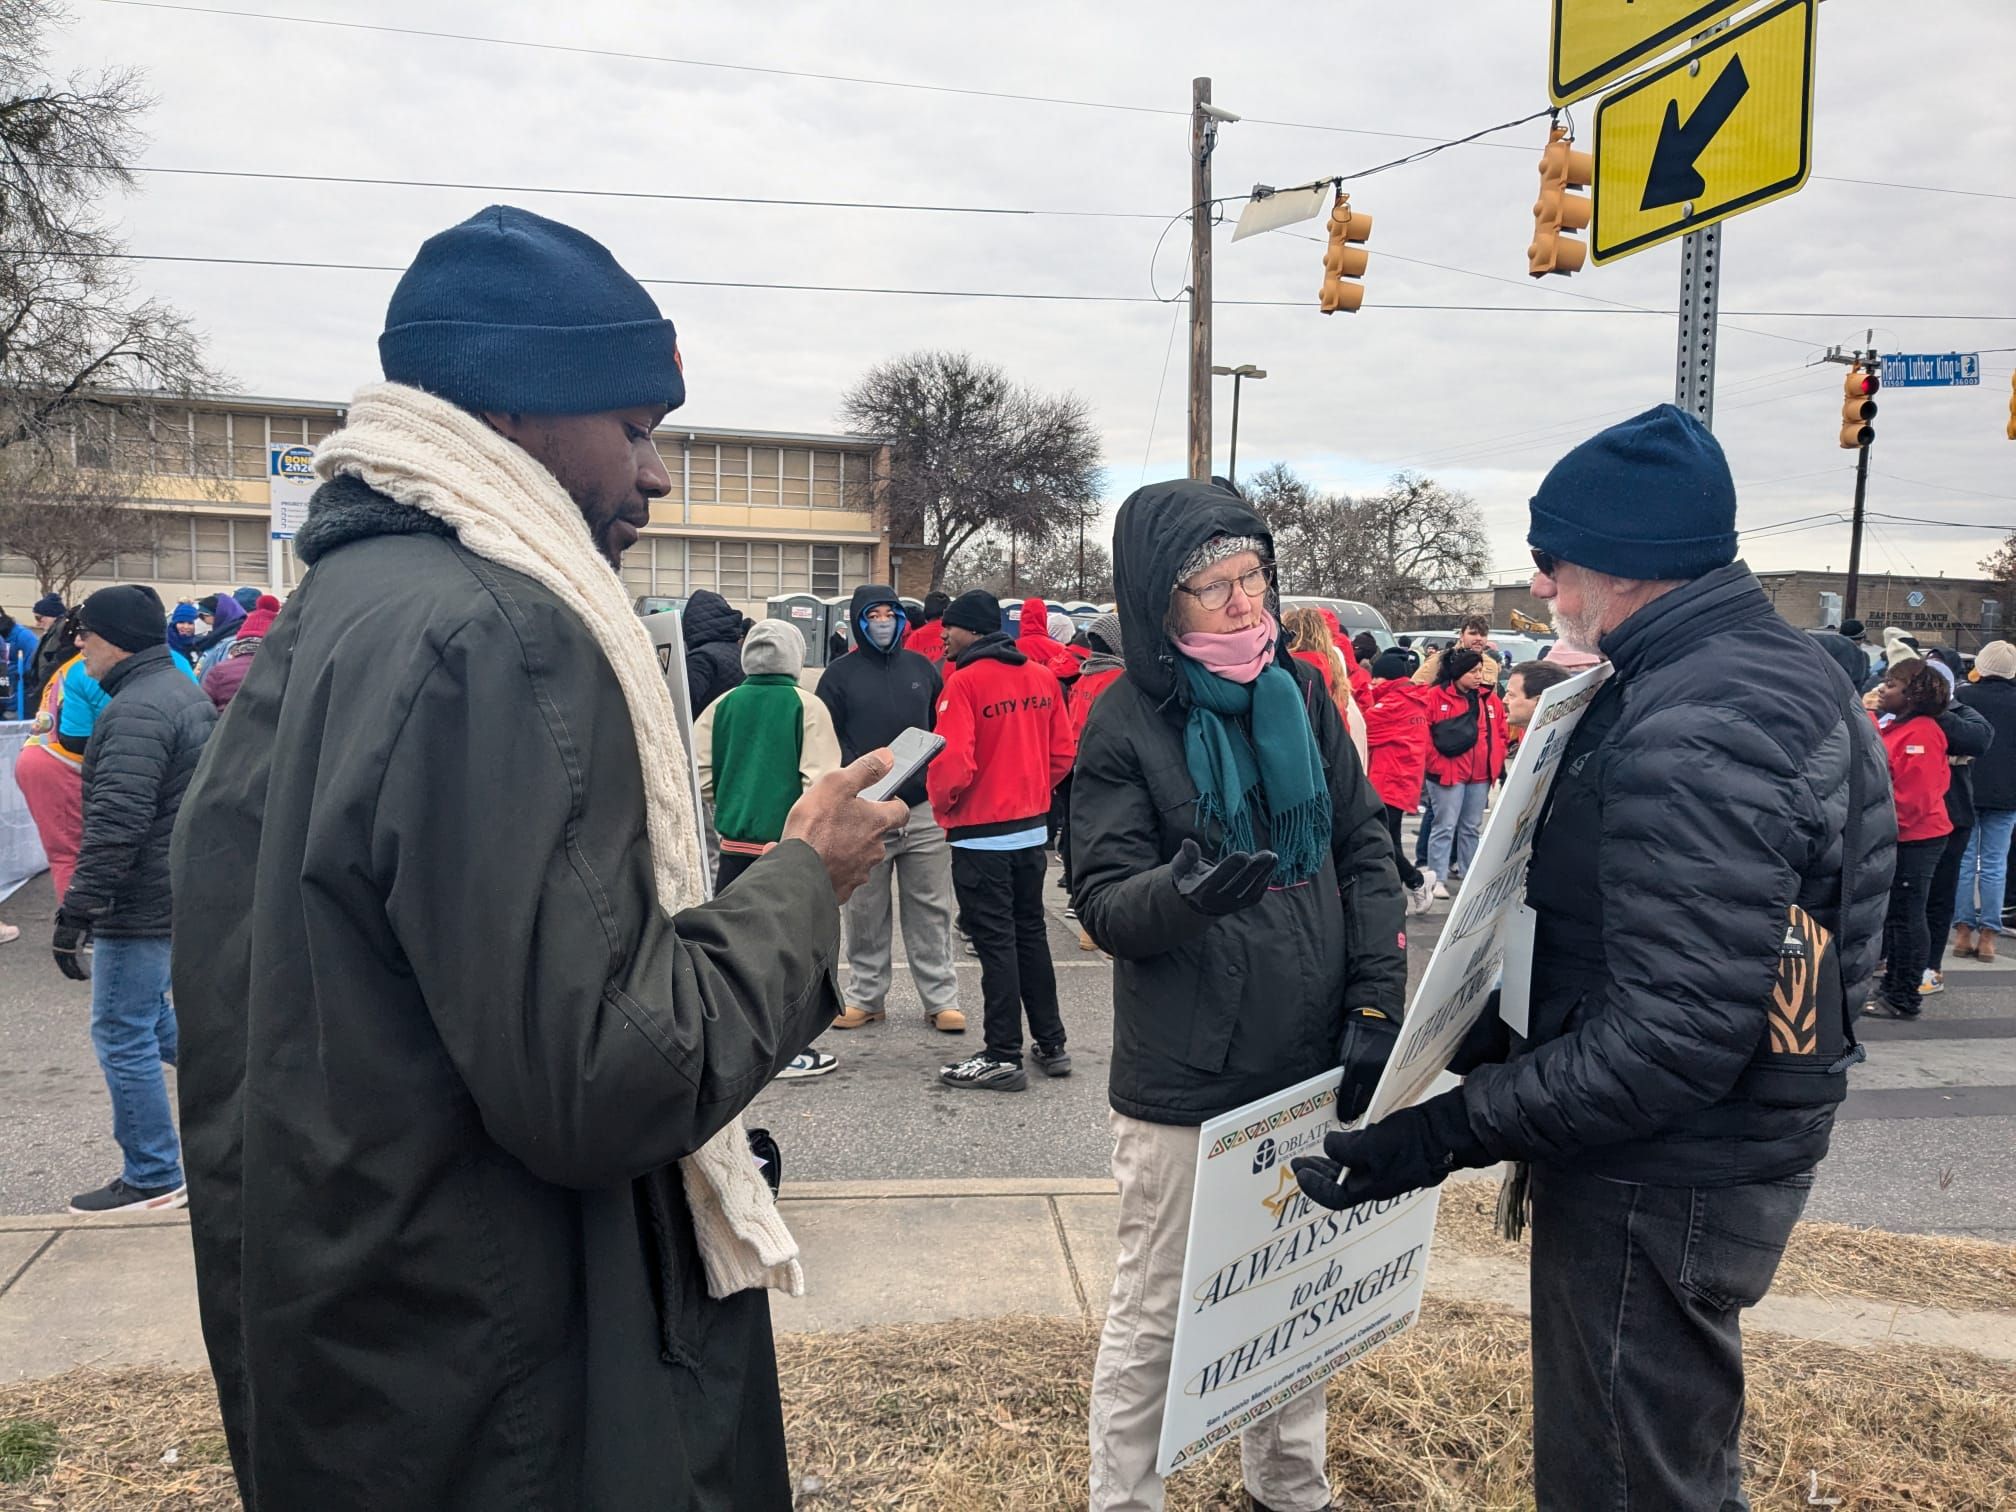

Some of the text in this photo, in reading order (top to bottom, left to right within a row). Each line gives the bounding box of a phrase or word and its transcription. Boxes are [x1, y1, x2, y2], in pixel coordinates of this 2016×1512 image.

[1882, 356, 1907, 381] Martin
[1909, 357, 1934, 380] Luther
[1936, 356, 1954, 385] King
[982, 699, 1017, 719] CITY
[1272, 1190, 1316, 1232] The
[1195, 1210, 1343, 1314] ALWAYS
[1290, 1258, 1343, 1311] to do
[1324, 1243, 1423, 1327] RIGHT
[1206, 1415, 1221, 1427] San
[1222, 1399, 1250, 1418] Antonio
[1250, 1384, 1273, 1401] Martin
[1273, 1370, 1296, 1388] Luther
[1324, 1341, 1343, 1357] March
[1344, 1333, 1357, 1345] and
[1357, 1312, 1391, 1337] Celebration
